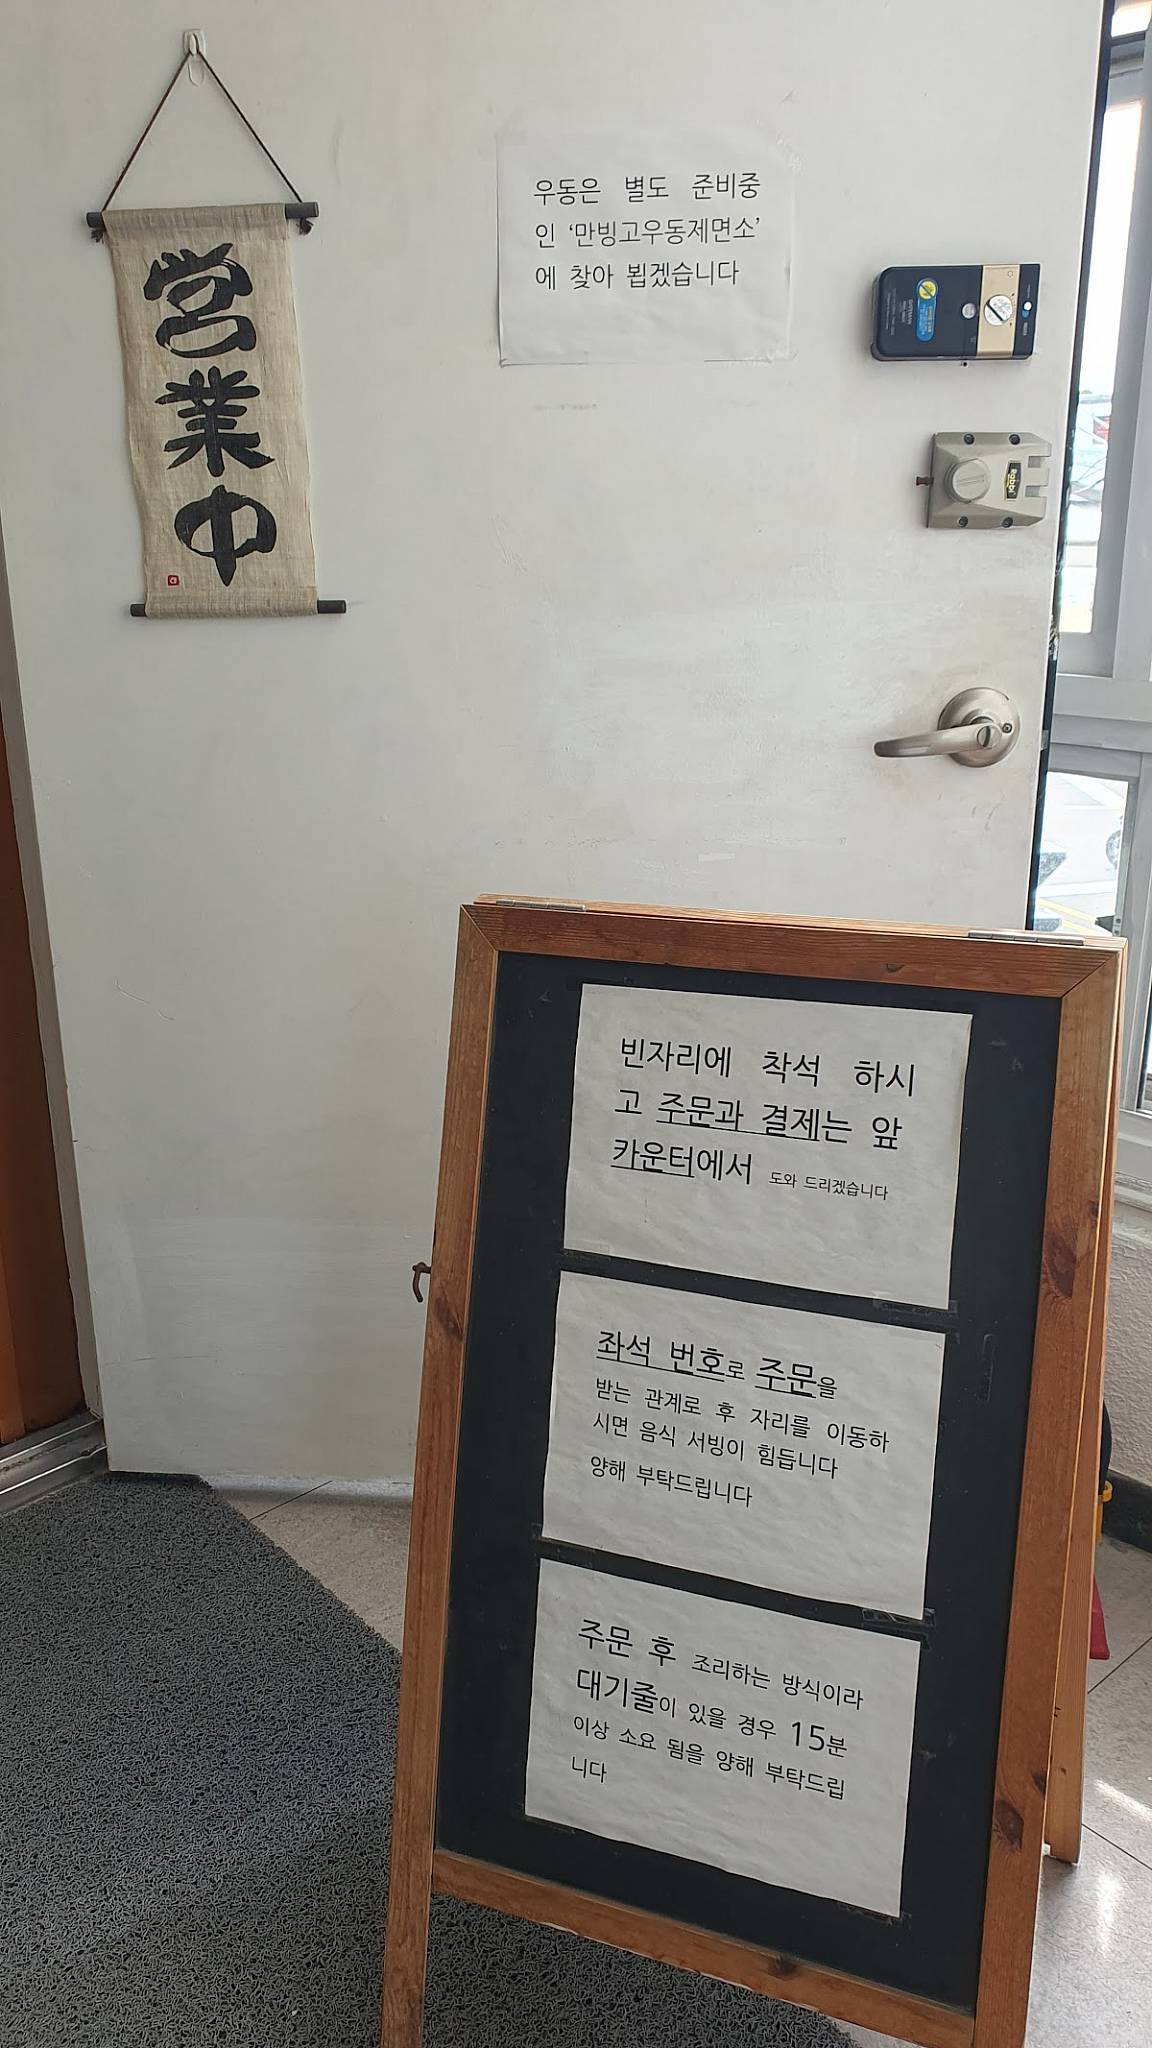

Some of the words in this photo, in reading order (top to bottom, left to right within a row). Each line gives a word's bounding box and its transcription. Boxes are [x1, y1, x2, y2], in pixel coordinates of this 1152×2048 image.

[533, 178, 601, 206] 우동은
[625, 175, 669, 203] 별도
[692, 172, 761, 200] 준비중
[535, 223, 555, 249] 인
[535, 265, 556, 290] 에
[570, 263, 614, 290] 찾아
[626, 260, 739, 288] 뵙겠습니다
[620, 1037, 732, 1078] 빈자리에
[761, 1049, 821, 1087] 착석
[853, 1060, 915, 1097] 하시
[614, 1089, 642, 1115] 고
[656, 1092, 744, 1132] 주문과
[761, 1103, 852, 1143] 결제는
[871, 1116, 902, 1150] 앞
[611, 1138, 753, 1184] 카운터에서
[769, 1171, 797, 1189] 도와
[803, 1176, 888, 1200] 드리겠습니다
[596, 1330, 651, 1367] 좌석
[669, 1341, 745, 1382] 번호로
[755, 1357, 838, 1399] 주문을
[592, 1413, 628, 1437] 시면
[639, 1421, 677, 1447] 음식
[687, 1432, 744, 1461] 서빙이
[757, 1445, 838, 1479] 힘듭니다
[595, 1378, 631, 1404] 받는
[644, 1387, 701, 1416] 관계로
[716, 1401, 736, 1423] 후
[750, 1407, 810, 1438] 자리를
[827, 1422, 889, 1453] 이동하
[591, 1456, 626, 1482] 양해
[636, 1464, 753, 1508] 부탁드립니다
[578, 1619, 633, 1658] 주문
[649, 1636, 676, 1667] 후
[691, 1654, 771, 1690] 조리하는
[782, 1674, 864, 1711] 방식이라
[577, 1668, 676, 1718] 대기줄이
[689, 1702, 727, 1729] 있을
[738, 1714, 777, 1740] 경우
[791, 1721, 848, 1758] 15분
[571, 1756, 607, 1783] 니다
[573, 1716, 609, 1740] 이상
[618, 1727, 657, 1751] 소요
[667, 1737, 704, 1765] 됨을
[716, 1751, 753, 1777] 양해
[765, 1762, 845, 1800] 부탁드립
